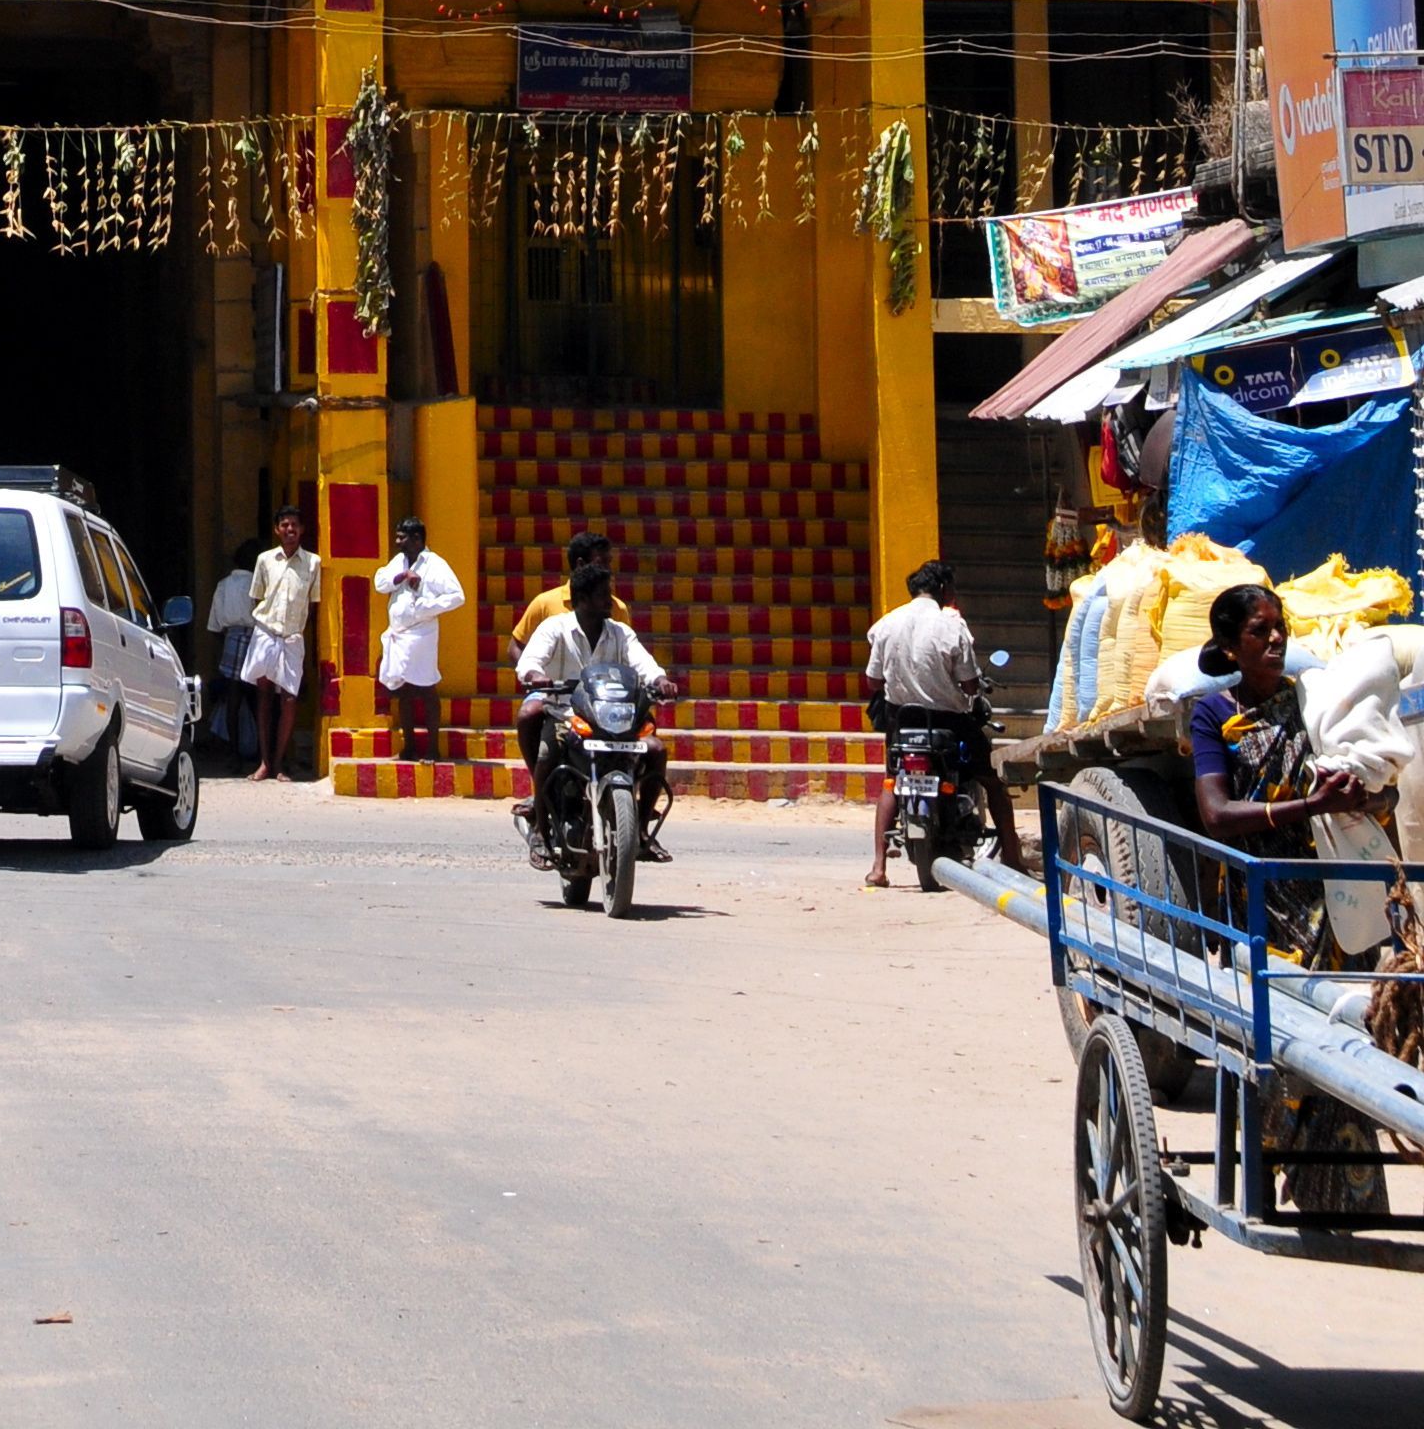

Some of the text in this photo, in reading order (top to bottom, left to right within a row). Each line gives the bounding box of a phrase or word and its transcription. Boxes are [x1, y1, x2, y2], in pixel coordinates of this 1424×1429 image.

[1353, 133, 1414, 173] STD
[1350, 353, 1392, 369] TATA
[1244, 370, 1285, 386] TATA
[1321, 364, 1396, 390] indicom
[2, 616, 52, 624] CHEVROLET
